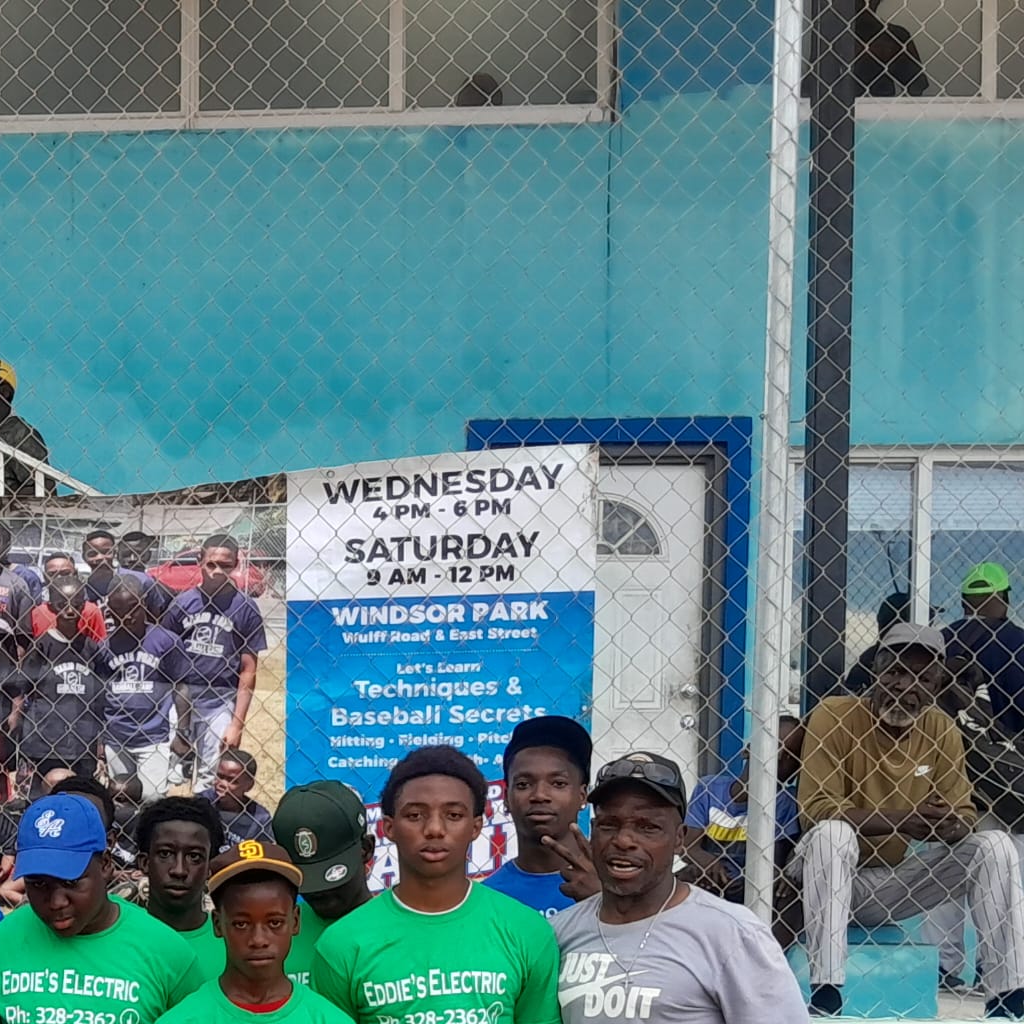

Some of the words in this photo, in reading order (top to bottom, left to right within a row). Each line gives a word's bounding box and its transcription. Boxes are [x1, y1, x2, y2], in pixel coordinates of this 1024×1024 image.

[323, 463, 564, 505] WEDNESDAY
[372, 506, 388, 521] 4
[394, 503, 431, 520] PM
[453, 500, 468, 517] 6
[475, 498, 512, 516] PM
[344, 531, 540, 564] SATURDAY
[366, 568, 382, 586] 9
[387, 567, 427, 585] AM
[449, 565, 473, 583] 12
[479, 564, 515, 581] PM
[331, 604, 465, 627] WINDSOR
[472, 600, 549, 622] PARK
[341, 630, 386, 645] Wulff
[389, 628, 431, 643] Road
[434, 628, 446, 642] &
[487, 625, 538, 640] Street
[396, 662, 433, 675] Let's
[436, 661, 482, 674] Learn
[353, 677, 499, 702] Techniques
[505, 675, 523, 696] &
[331, 703, 442, 728] Baseball
[448, 704, 547, 725] Secrets
[477, 729, 513, 744] Pitc
[559, 951, 617, 984] JUST
[1, 968, 59, 996] EDDIE'S
[61, 968, 140, 1003] ELECTRIC
[363, 973, 427, 1007] EDDIE'S
[428, 968, 508, 996] ELECTRIC
[5, 1005, 31, 1024] Ph:
[583, 984, 626, 1019] DO
[626, 986, 662, 1019] IT
